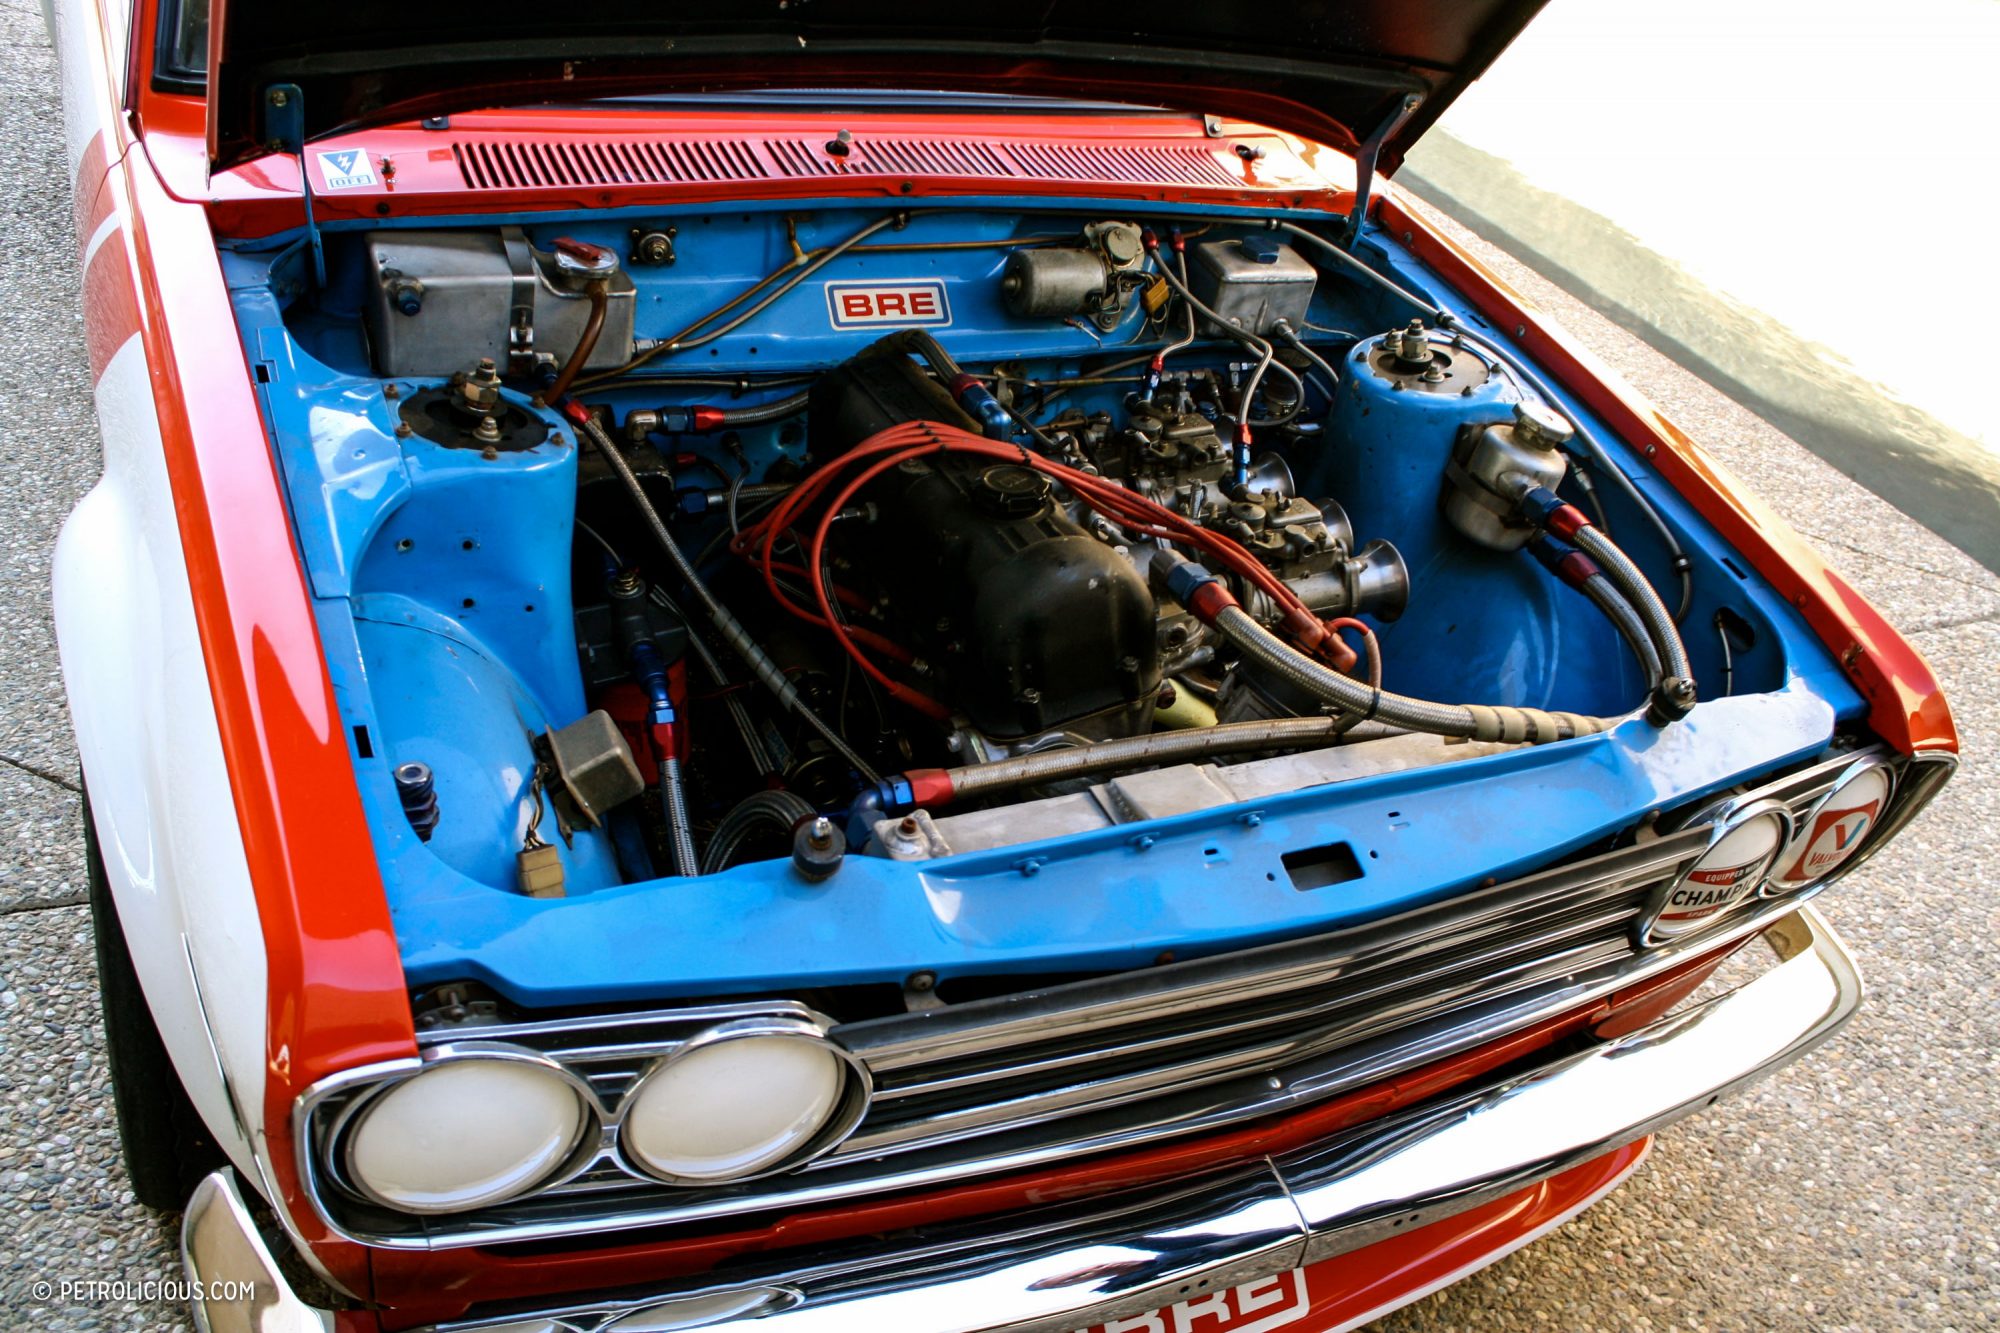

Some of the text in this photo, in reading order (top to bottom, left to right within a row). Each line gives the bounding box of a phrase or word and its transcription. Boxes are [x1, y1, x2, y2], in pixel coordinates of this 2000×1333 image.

[335, 176, 366, 186] OFF
[842, 293, 936, 317] BRE
[1705, 868, 1745, 882] EQUIPPED
[1672, 875, 1758, 906] CHAMPIO
